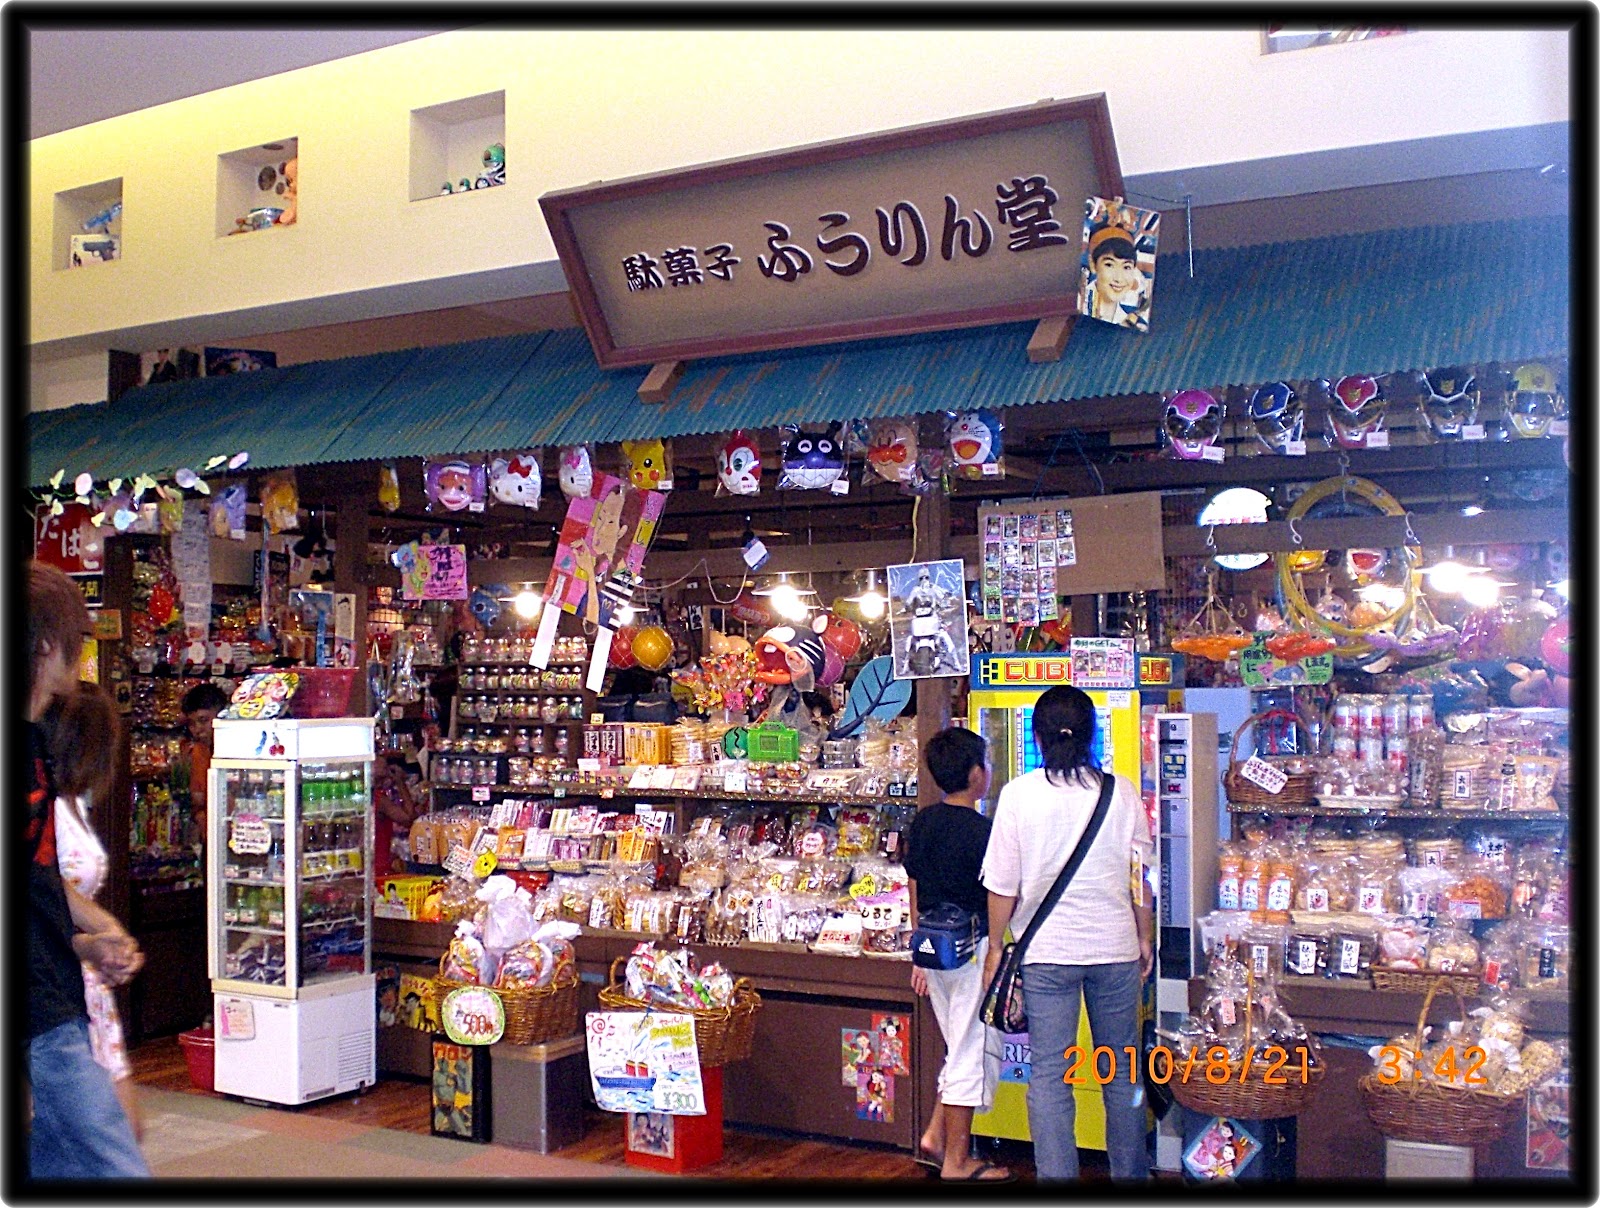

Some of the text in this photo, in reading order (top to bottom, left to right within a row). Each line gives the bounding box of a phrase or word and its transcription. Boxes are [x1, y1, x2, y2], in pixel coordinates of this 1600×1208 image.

[621, 242, 742, 293] 駄菓子
[756, 175, 1069, 283] ふうりん堂
